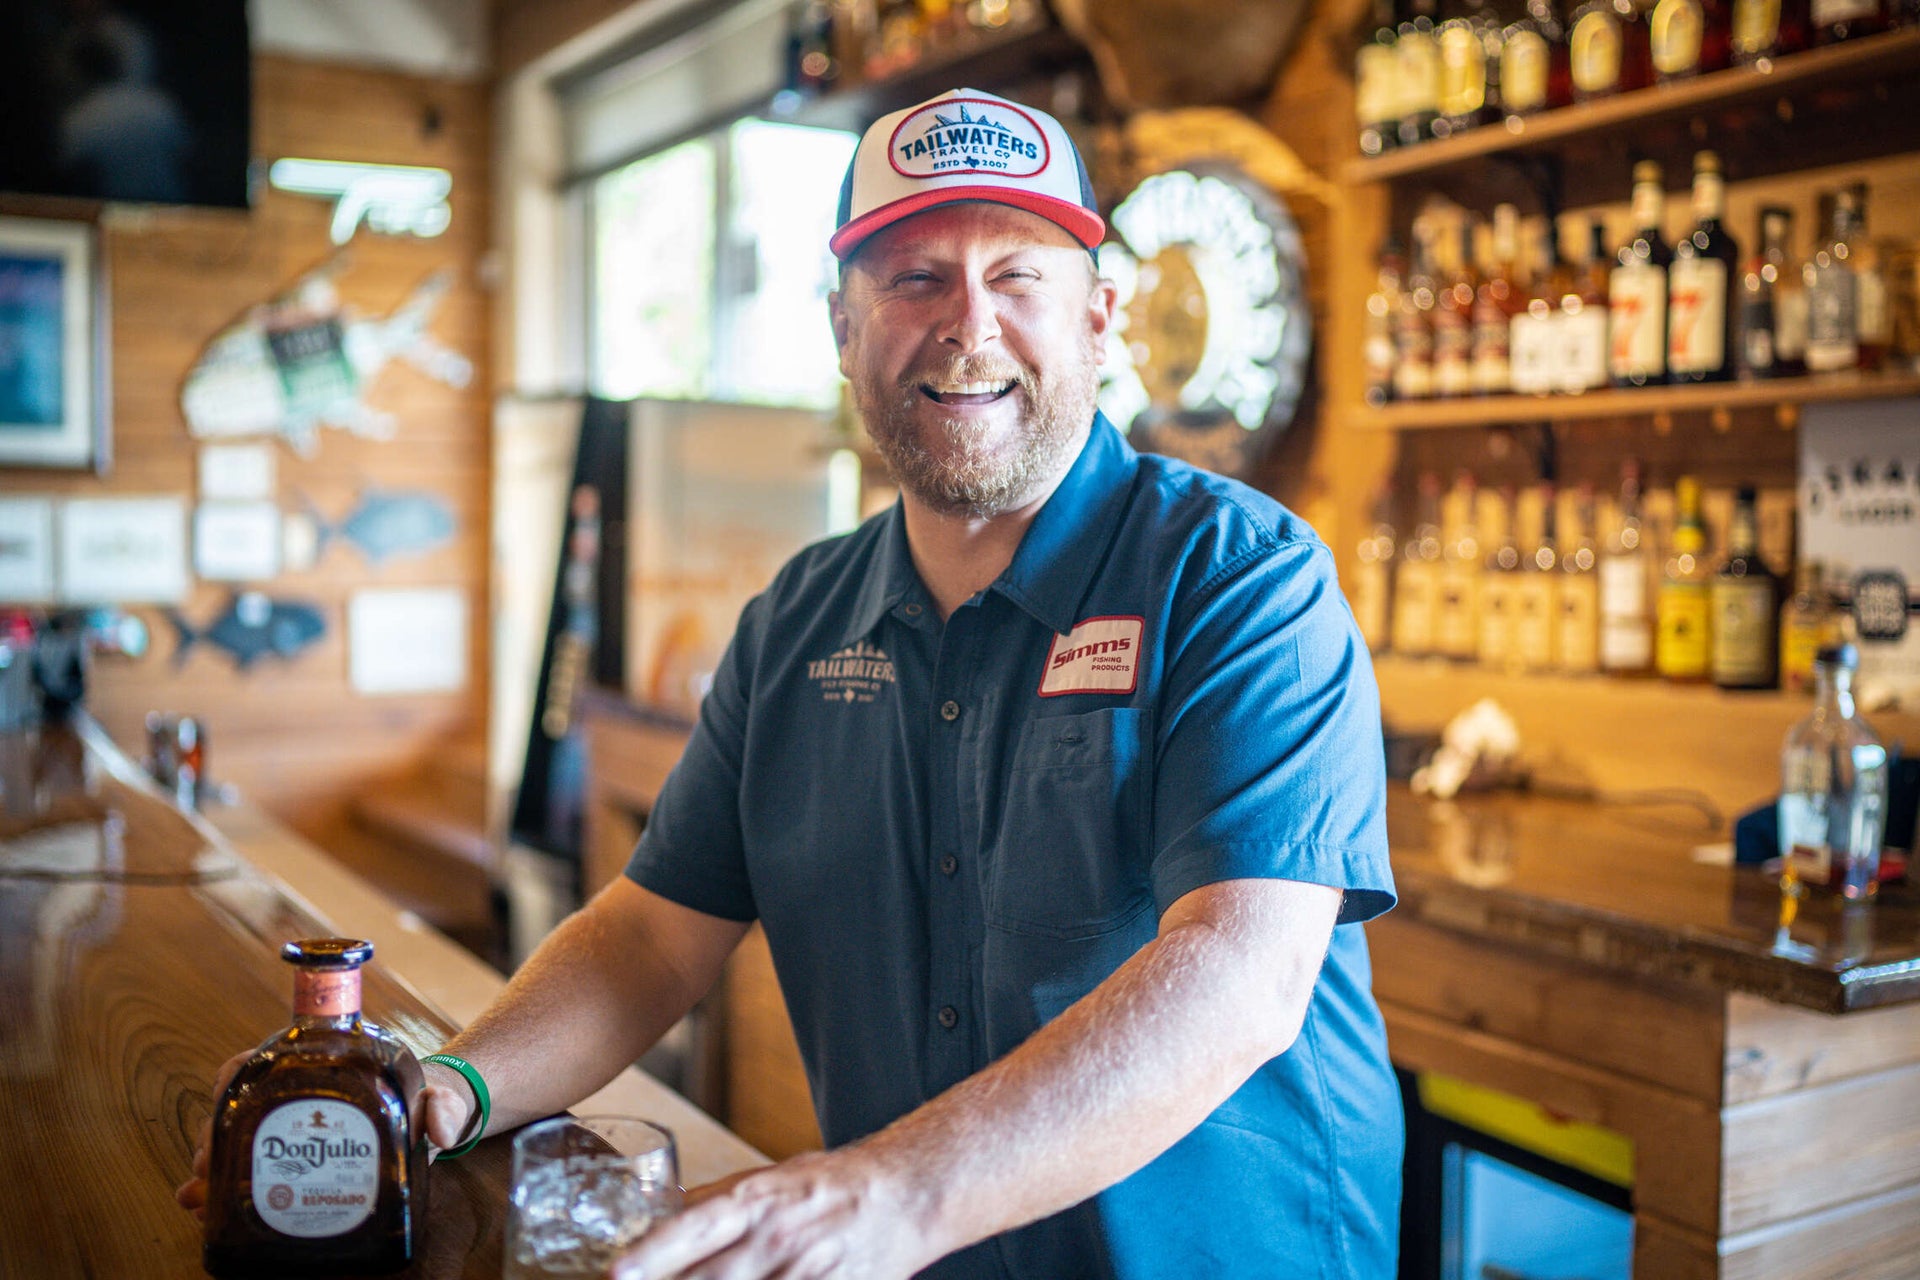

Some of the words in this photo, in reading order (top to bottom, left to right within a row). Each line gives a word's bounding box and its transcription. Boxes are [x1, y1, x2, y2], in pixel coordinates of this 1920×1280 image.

[900, 127, 1038, 160] TAILWATERS
[929, 145, 988, 160] TRAVEL
[933, 159, 960, 170] ESTD
[982, 159, 1008, 169] 2007
[1092, 656, 1122, 664] FISHING
[301, 1194, 367, 1206] REPOSADO
